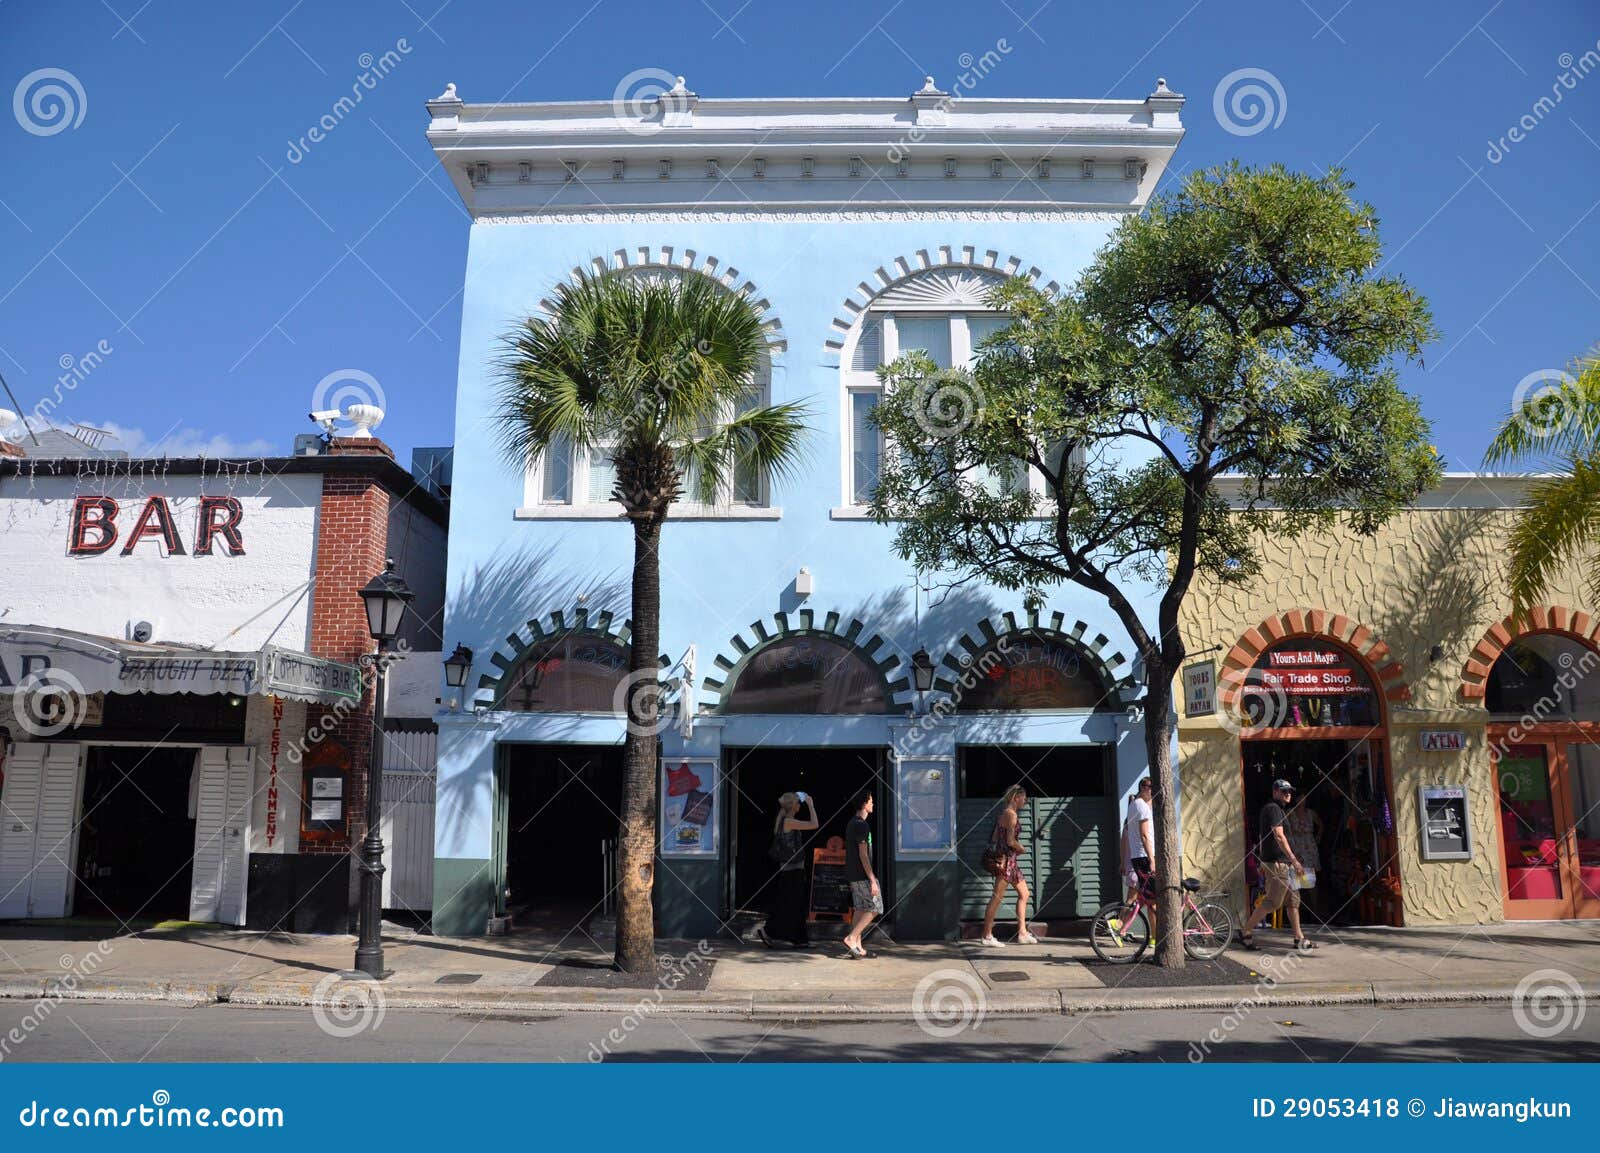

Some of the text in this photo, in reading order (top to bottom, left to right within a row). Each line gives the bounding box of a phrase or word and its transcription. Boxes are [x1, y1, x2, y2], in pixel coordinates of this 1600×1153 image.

[68, 495, 246, 556] BAR
[1273, 652, 1296, 664] Yours
[1297, 651, 1313, 663] And
[118, 659, 257, 682] DRAUGHT BEER
[1009, 667, 1057, 691] BAR
[1263, 673, 1352, 685] Fair Trade Shop
[1427, 733, 1460, 749] ATM
[266, 694, 283, 848] ENTERTAINMENT
